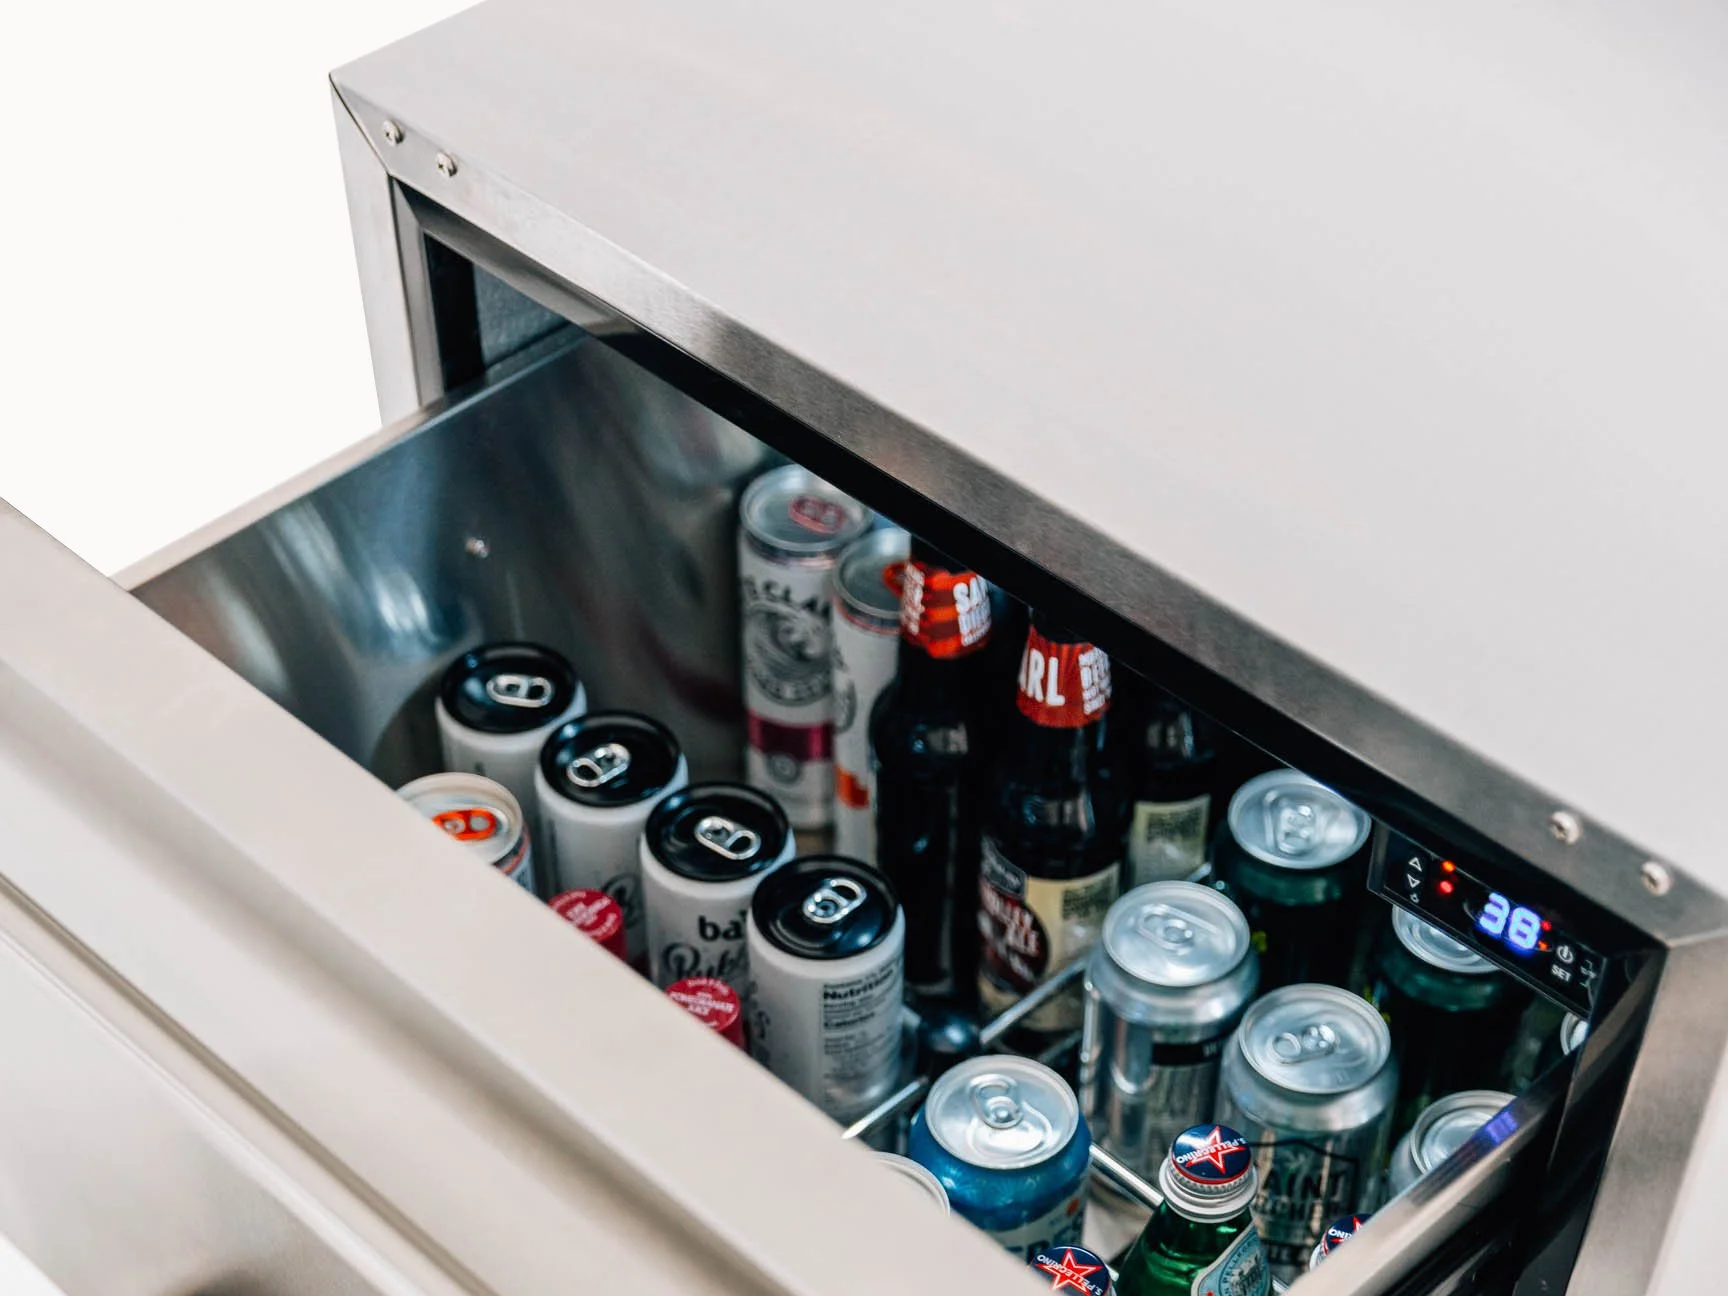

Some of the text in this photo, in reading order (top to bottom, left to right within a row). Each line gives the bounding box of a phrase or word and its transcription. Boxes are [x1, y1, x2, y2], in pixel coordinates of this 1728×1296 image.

[699, 910, 748, 942] ba
[1480, 892, 1541, 950] 38
[1551, 964, 1572, 982] SET
[1262, 1166, 1349, 1201] AINT
[1036, 1254, 1104, 1296] S.PELLEGRINO
